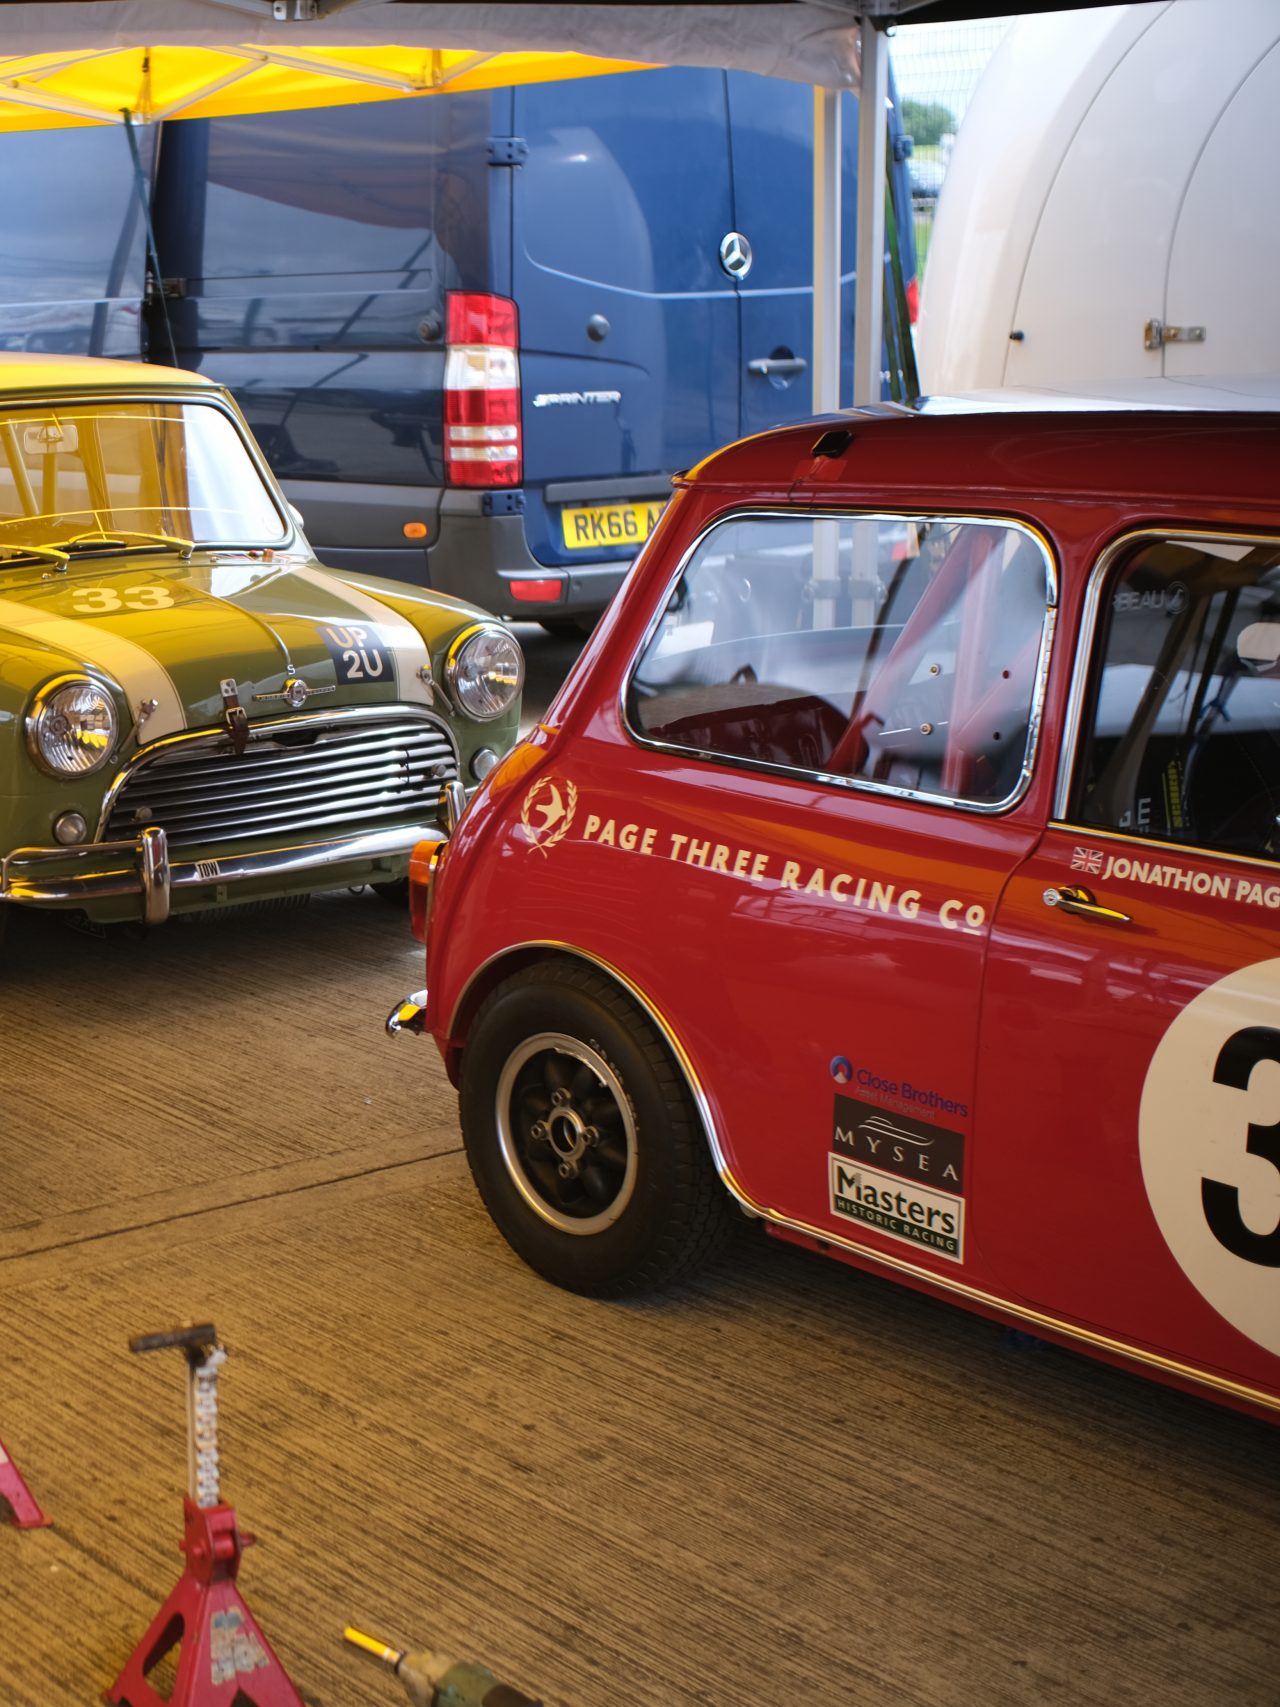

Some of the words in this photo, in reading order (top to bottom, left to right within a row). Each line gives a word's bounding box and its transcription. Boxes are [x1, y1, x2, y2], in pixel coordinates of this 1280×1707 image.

[533, 391, 621, 407] SPRINTER
[574, 511, 638, 541] RK66
[72, 586, 174, 613] 33
[326, 626, 368, 649] UP
[343, 649, 384, 680] 2U
[197, 861, 218, 878] TOW
[582, 814, 658, 855] PAGE
[670, 833, 769, 882] THREE
[780, 860, 922, 919] RACING
[1101, 856, 1231, 899] JONATHON
[856, 1069, 898, 1094] Close
[901, 1083, 969, 1117] Brothers
[834, 1125, 960, 1182] MYSEA
[1200, 1024, 1280, 1269] 3
[836, 1165, 956, 1235] Masters
[837, 1199, 898, 1230] HISTORIC
[903, 1225, 955, 1251] RACING
